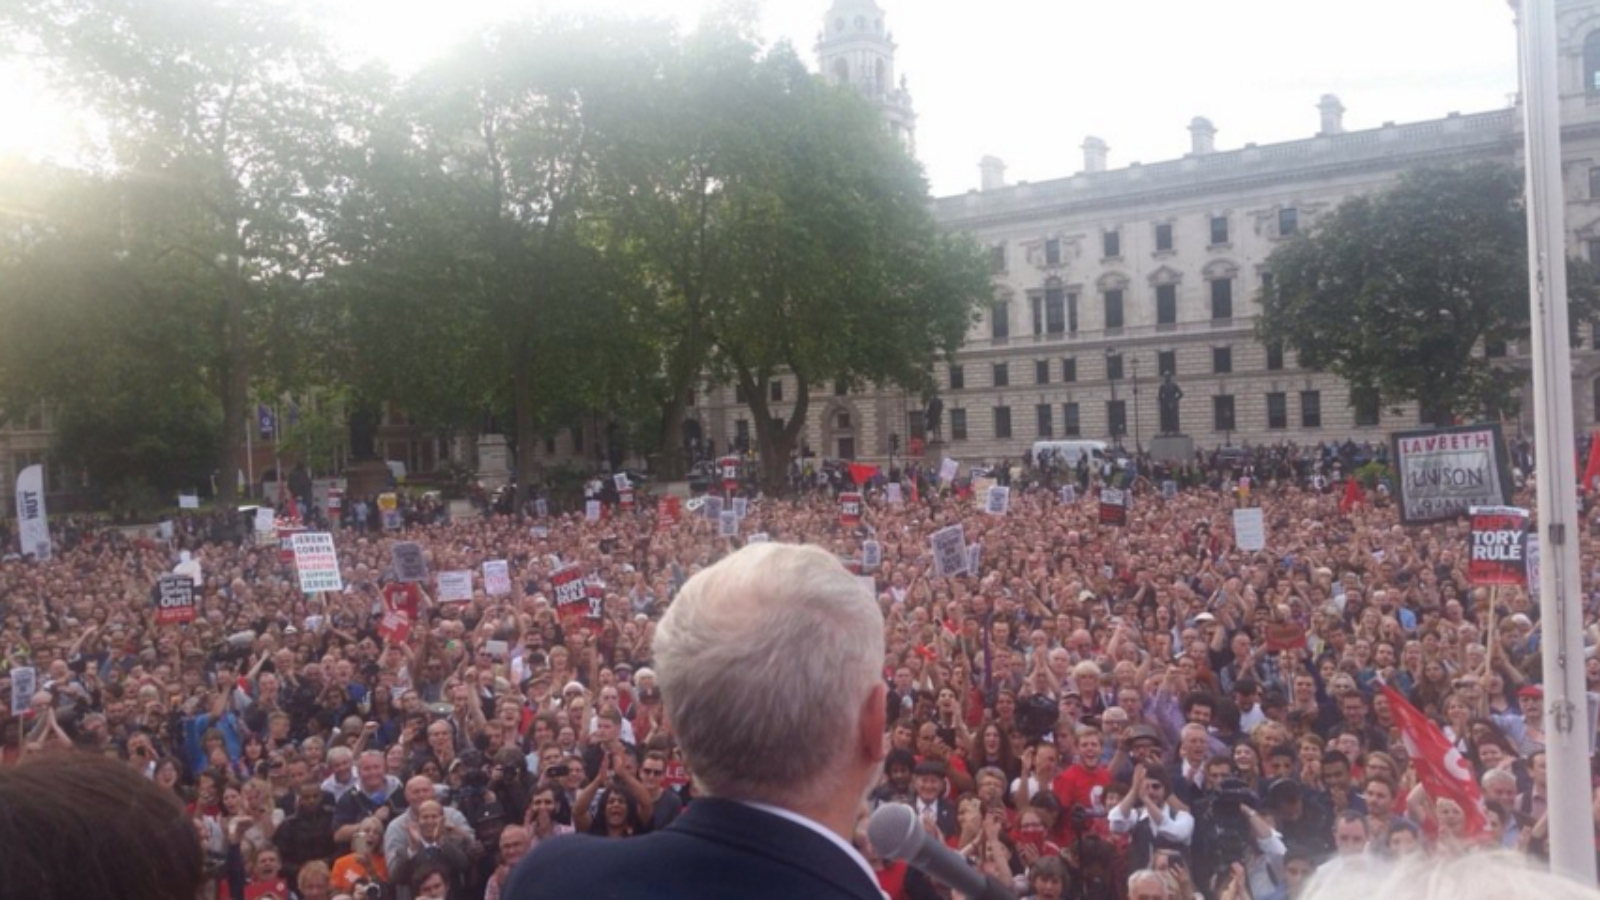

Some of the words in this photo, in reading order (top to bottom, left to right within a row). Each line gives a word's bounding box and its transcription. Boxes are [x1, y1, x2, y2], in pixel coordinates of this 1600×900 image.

[24, 490, 39, 519] NUT
[294, 535, 330, 544] JEREMY
[1472, 530, 1523, 546] TORY
[1473, 545, 1522, 560] RULE
[304, 580, 339, 589] JEREMY
